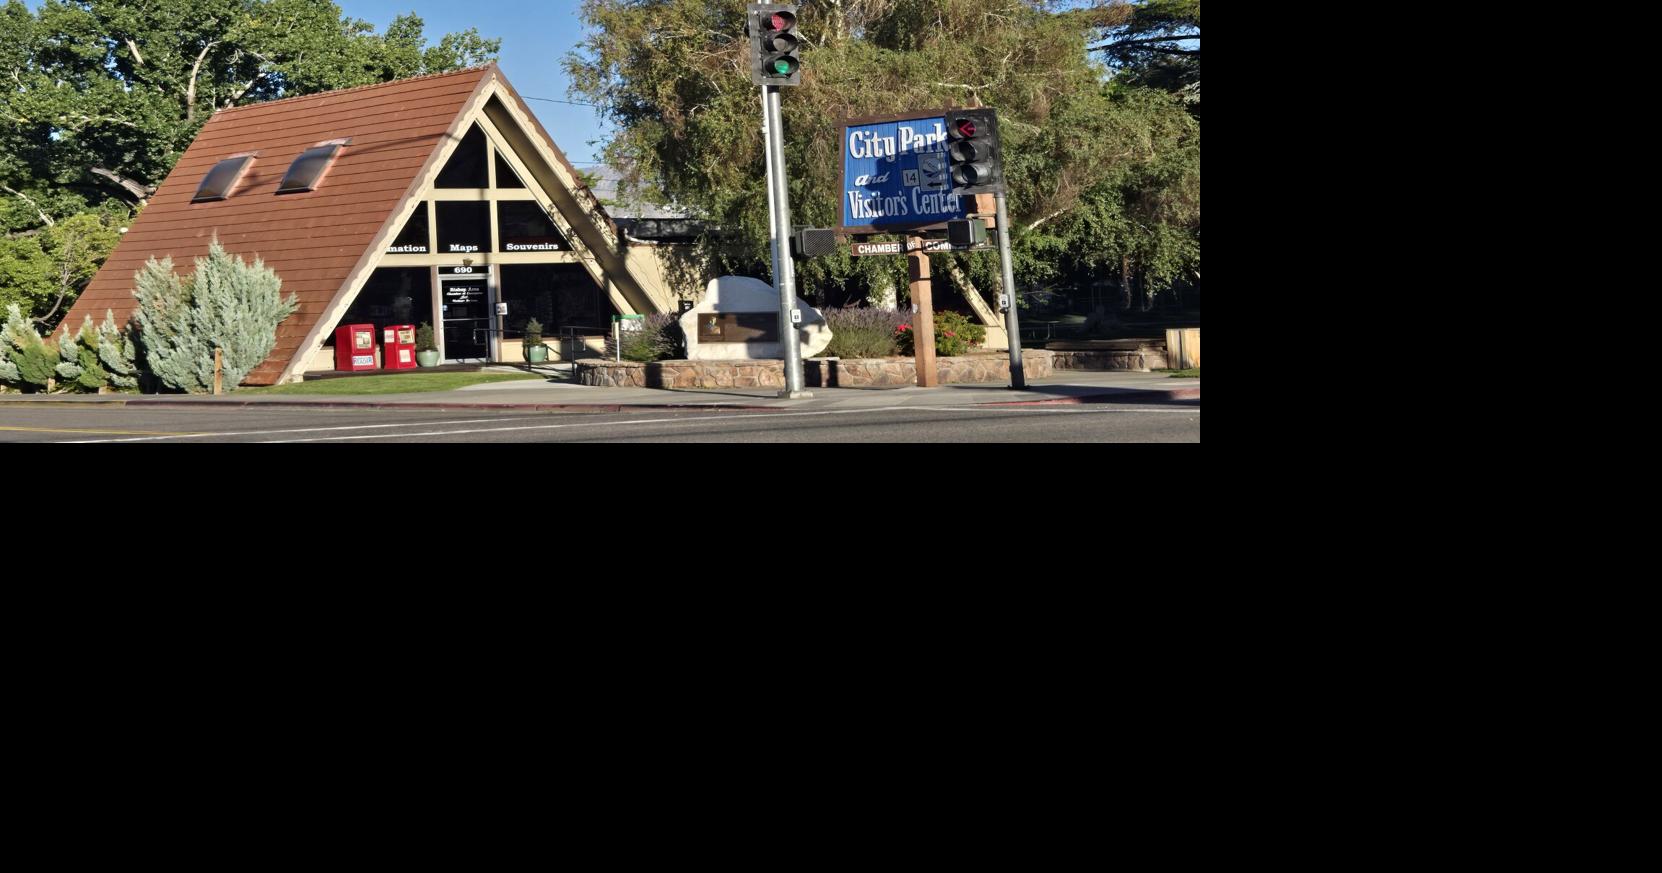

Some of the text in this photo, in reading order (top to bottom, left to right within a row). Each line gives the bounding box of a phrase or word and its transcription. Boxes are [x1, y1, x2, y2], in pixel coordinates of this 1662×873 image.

[849, 123, 949, 162] City Park
[854, 171, 890, 186] and
[905, 173, 916, 183] 14
[848, 186, 961, 219] Visitor's Center
[450, 244, 478, 253] Maps
[506, 243, 558, 251] Souvenirs
[858, 243, 905, 254] CHAMBER
[907, 241, 916, 250] OF
